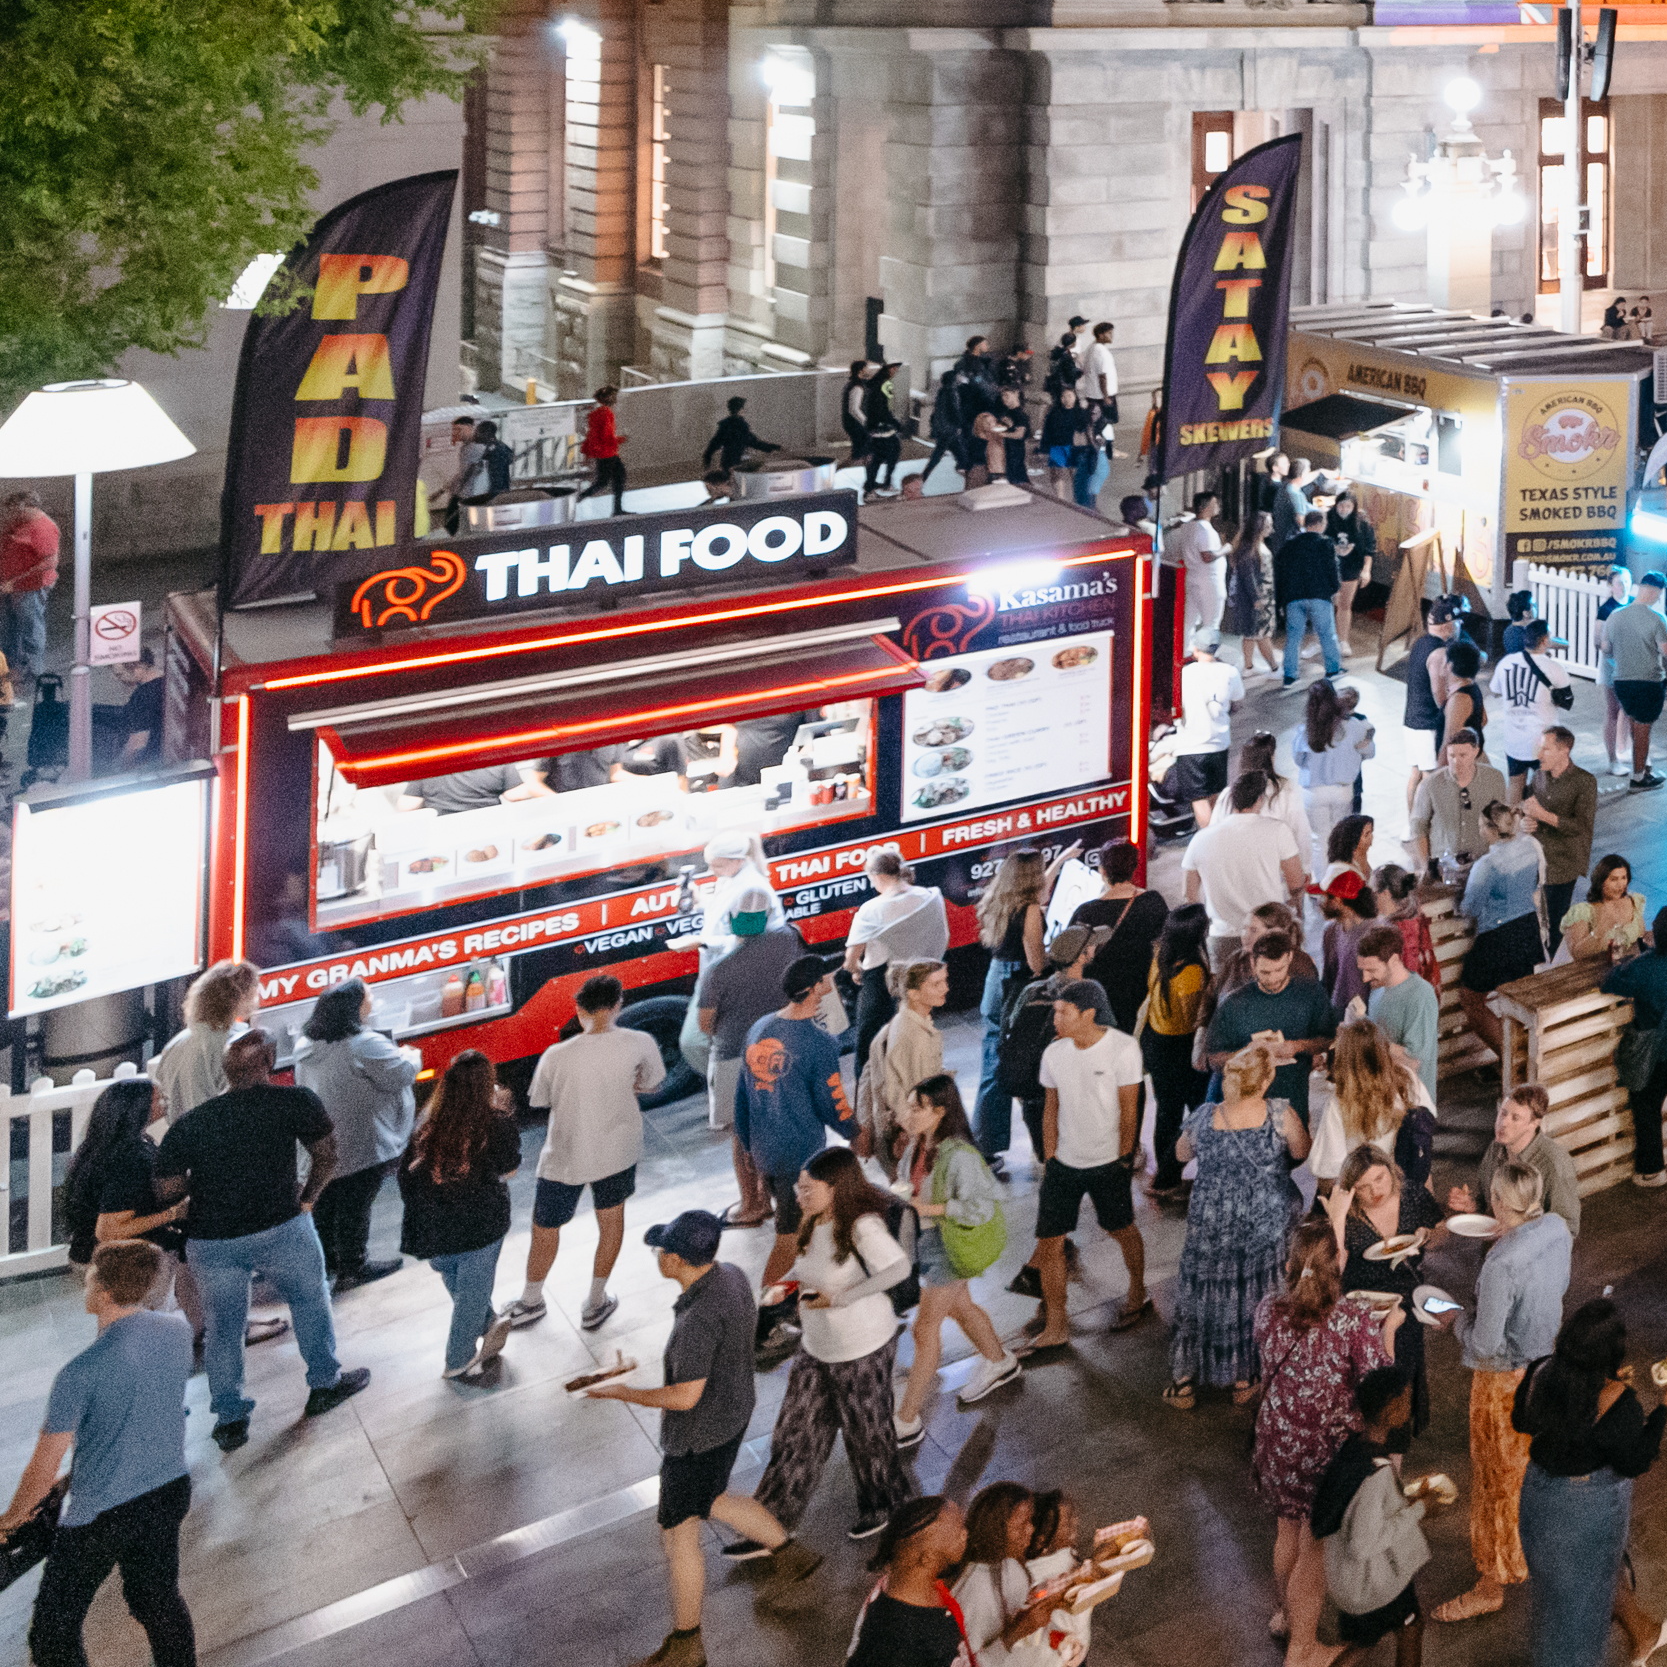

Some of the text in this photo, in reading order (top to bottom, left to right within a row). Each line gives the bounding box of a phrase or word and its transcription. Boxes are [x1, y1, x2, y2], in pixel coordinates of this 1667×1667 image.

[1203, 184, 1272, 412] SATAY
[289, 252, 409, 484] PAD
[1347, 362, 1427, 400] AMERICAN BBQ
[1540, 396, 1603, 415] AMERICAN BBQ
[1179, 418, 1275, 447] SKEWERS
[1519, 485, 1618, 502] TEXAS STYLE
[254, 499, 397, 555] THAI
[1519, 505, 1618, 522] SMOKED BBQ
[474, 509, 849, 603] THAI FOOD
[997, 571, 1118, 612] Kasama's
[1041, 597, 1116, 619] KITCHEN
[941, 790, 1128, 847] FRESH & HEALTHY
[775, 854, 832, 883] THAI
[795, 880, 867, 906] GLUTEN
[257, 913, 580, 1000] MY GRANMA'S RECIPES
[584, 926, 654, 955] VEGAN
